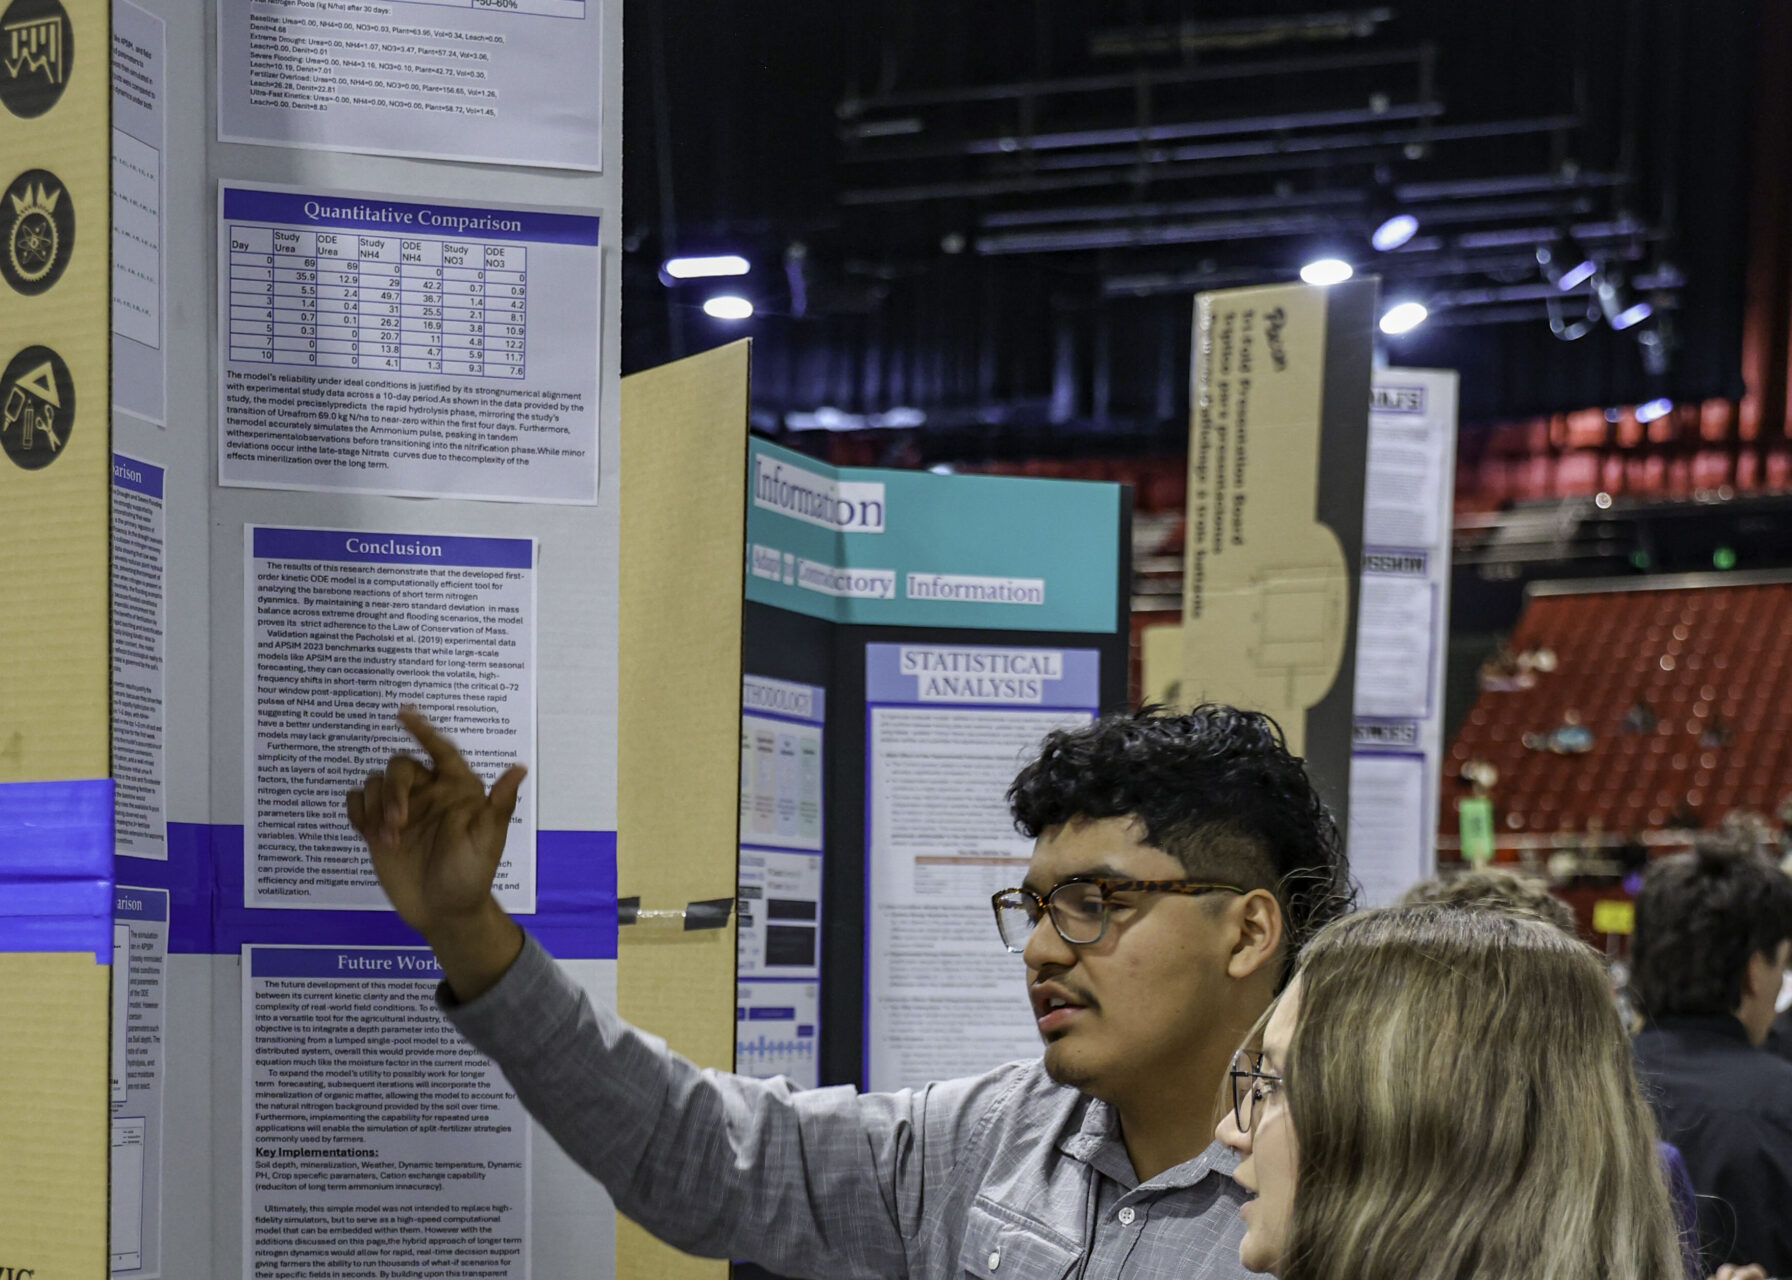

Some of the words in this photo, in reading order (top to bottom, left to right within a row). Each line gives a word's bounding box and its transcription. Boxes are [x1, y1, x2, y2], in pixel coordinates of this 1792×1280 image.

[304, 201, 414, 225] Quantitative
[418, 210, 522, 232] Comparison
[232, 240, 249, 251] Day
[275, 244, 296, 253] Urea
[317, 247, 338, 256] Urea
[360, 250, 380, 259] NH4
[402, 253, 421, 262] NH4
[444, 256, 464, 266] NO3
[486, 259, 505, 268] NO3
[275, 232, 300, 243] Study
[317, 235, 337, 244] ODE
[360, 238, 385, 249] Study
[402, 242, 421, 251] ODE
[444, 244, 469, 255] Study
[486, 248, 505, 257] ODE
[304, 259, 315, 267] 69
[347, 262, 358, 270] 69
[268, 270, 271, 278] 1
[296, 272, 315, 281] 35.9
[339, 276, 358, 284] 12.9
[389, 279, 400, 287] 29
[423, 281, 442, 290] 42.2
[469, 285, 483, 293] 0.7
[511, 287, 525, 295] 0.9
[267, 283, 273, 291] 2
[301, 286, 315, 294] 5.5
[344, 289, 358, 297] 2.4
[381, 292, 400, 300] 49.7
[469, 298, 483, 306] 1.4
[511, 301, 525, 309] 4.2
[267, 297, 273, 305] 3
[301, 299, 315, 307] 1.4
[344, 302, 358, 311] 0.4
[389, 305, 399, 313] 31
[423, 308, 442, 316] 25.5
[469, 311, 482, 319] 2.1
[267, 310, 273, 319] 4
[301, 313, 315, 321] 0.7
[344, 316, 357, 324] 0.1
[469, 324, 483, 333] 3.8
[506, 327, 525, 335] 10.9
[267, 324, 273, 332] 5
[301, 326, 315, 334] 0.3
[381, 332, 400, 340] 20.7
[431, 335, 440, 343] 11
[469, 338, 483, 346] 4.8
[506, 340, 525, 349] 12.2
[267, 337, 272, 346] 7
[381, 345, 400, 353] 13.8
[428, 348, 441, 356] 4.7
[506, 354, 525, 362] 11.7
[262, 351, 272, 359] 10
[386, 358, 399, 366] 4.1
[427, 362, 441, 370] 1.3
[469, 364, 483, 373] 9.3
[511, 367, 525, 375] 7.6
[226, 370, 243, 380] The
[241, 371, 278, 382] model's
[276, 373, 317, 386] reliability
[316, 376, 342, 386] under
[343, 377, 363, 387] ideal
[364, 378, 408, 390] conditions
[409, 381, 417, 390] is
[418, 382, 451, 394] justified
[452, 384, 462, 395] by
[463, 384, 473, 393] its
[541, 389, 581, 402] alignment
[113, 463, 142, 483] arison
[755, 460, 882, 526] Information
[346, 537, 442, 557] Conclusion
[267, 561, 283, 570] The
[282, 562, 312, 571] results
[311, 563, 322, 571] of
[321, 563, 339, 572] this
[338, 564, 376, 573] research
[376, 566, 428, 576] demonstrate
[429, 568, 445, 576] that
[447, 569, 461, 577] the
[461, 569, 504, 581] developed
[908, 576, 1041, 602] Information
[904, 651, 1057, 675] STATISTICAL
[925, 678, 1038, 698] ANALYSIS
[337, 955, 393, 970] Future
[397, 955, 443, 971] Work
[278, 1069, 309, 1079] expand
[310, 1069, 324, 1077] the
[325, 1069, 358, 1077] model's
[358, 1069, 382, 1079] utility
[392, 1070, 426, 1080] possibly
[426, 1070, 446, 1078] work
[447, 1070, 459, 1078] for
[460, 1070, 485, 1080] longer
[255, 1147, 276, 1159] Key
[279, 1147, 379, 1159] Implementations:
[271, 1161, 298, 1170] depth,
[299, 1161, 359, 1170] mineralization,
[398, 1161, 433, 1170] Dynamic
[487, 1161, 521, 1170] Dynamic
